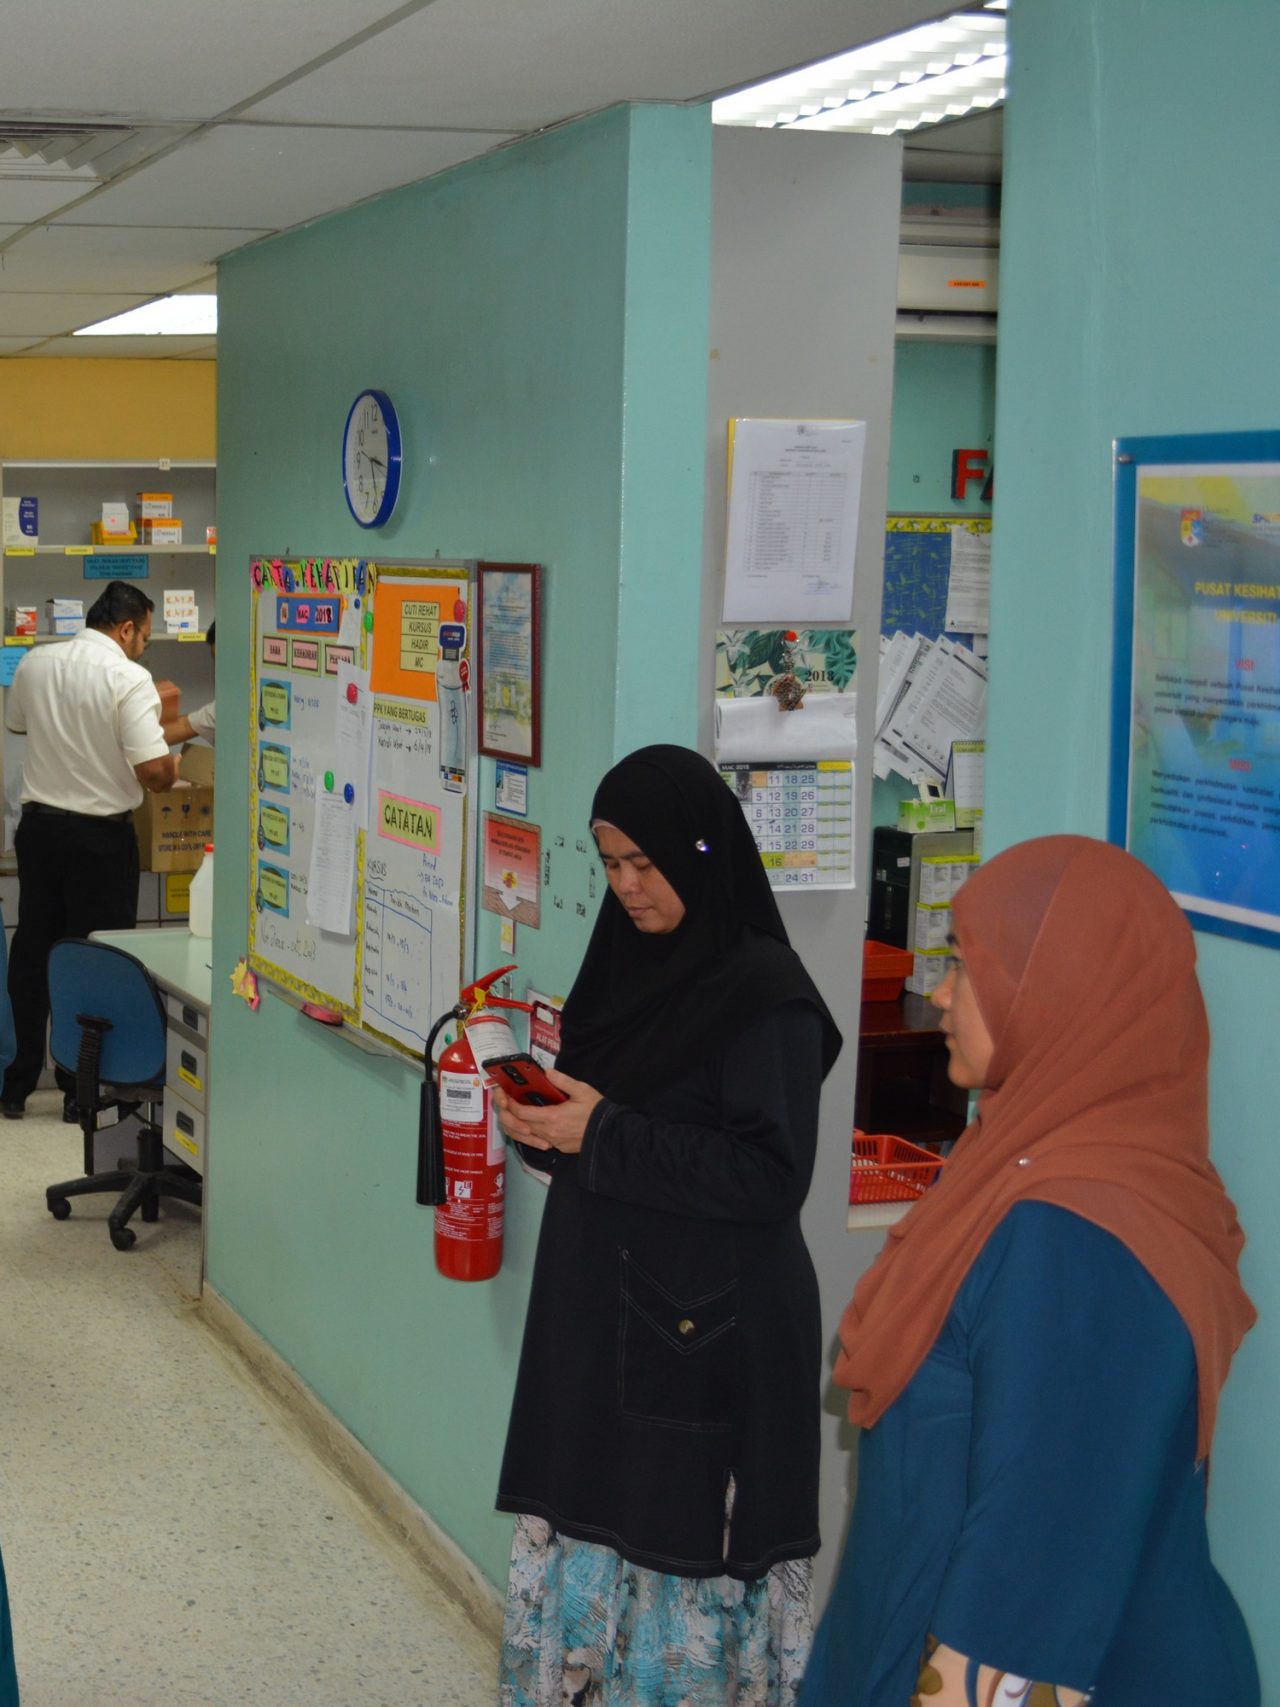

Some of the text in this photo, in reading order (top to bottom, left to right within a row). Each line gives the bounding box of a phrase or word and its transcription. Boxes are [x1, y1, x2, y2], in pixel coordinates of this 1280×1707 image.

[805, 670, 834, 682] 2018
[770, 774, 815, 784] 11 18 25
[770, 791, 781, 801] 12
[785, 791, 798, 801] 19
[801, 790, 815, 800] 26
[770, 808, 781, 817] 13
[784, 808, 798, 817] 20
[801, 807, 814, 816] 27
[384, 804, 432, 840] CATATAN
[770, 825, 781, 834] 14
[784, 824, 797, 833] 21
[801, 824, 815, 833] 28
[770, 841, 782, 850] 15
[784, 840, 798, 850] 22
[801, 840, 815, 850] 29
[770, 857, 782, 867] 16
[785, 873, 799, 883] 24
[801, 873, 814, 882] 31
